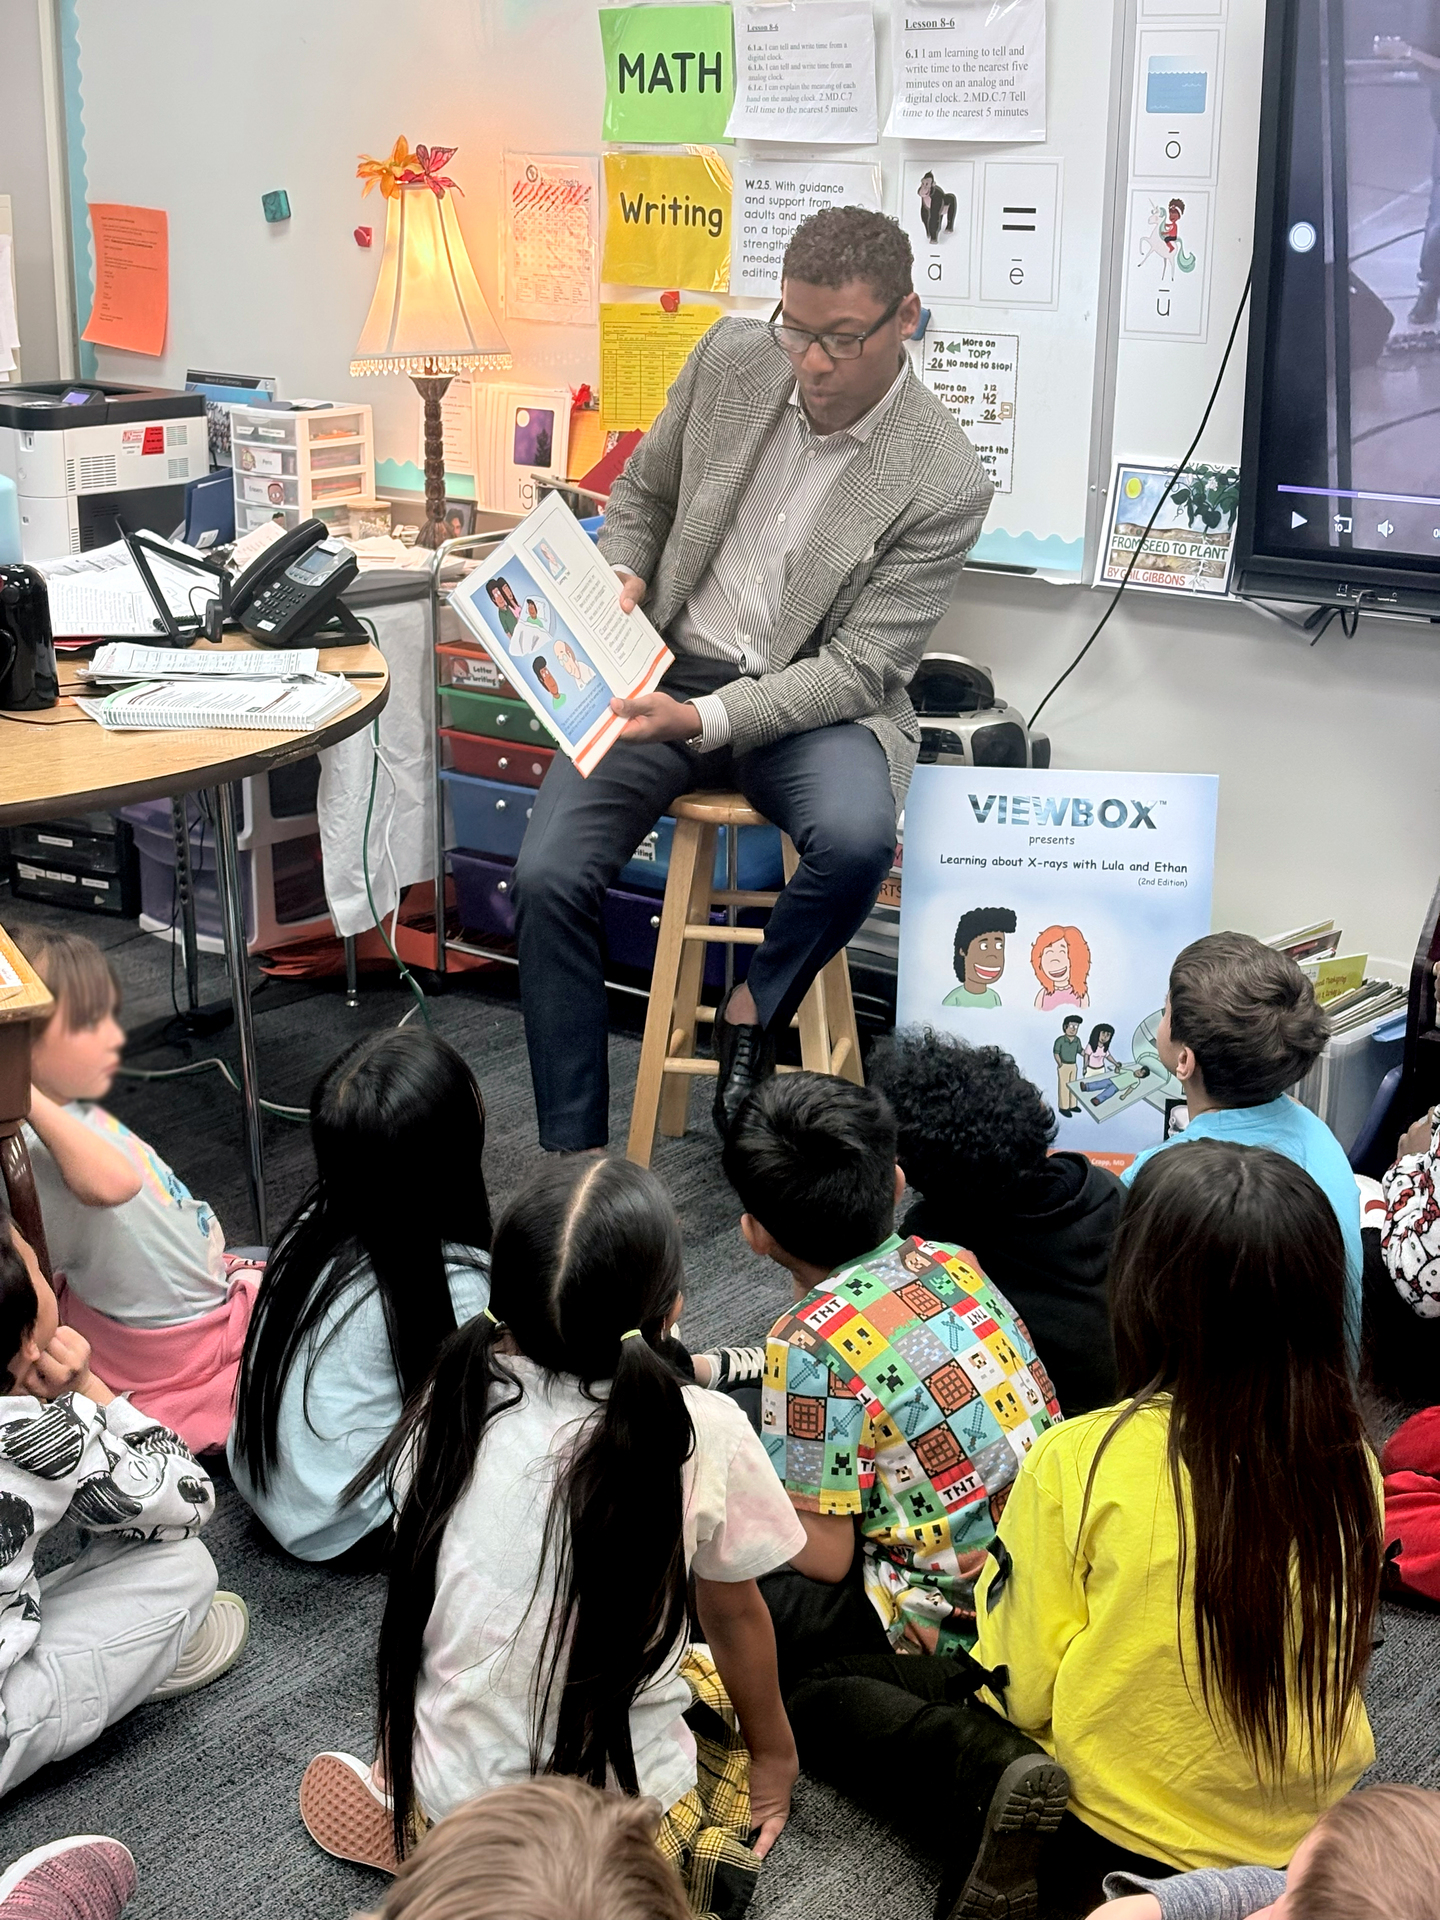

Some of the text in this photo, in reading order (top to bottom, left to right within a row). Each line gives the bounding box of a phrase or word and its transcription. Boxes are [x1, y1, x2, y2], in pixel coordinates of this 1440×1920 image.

[905, 18, 955, 29] Lesson 8-6
[906, 49, 918, 58] 6.1
[922, 49, 925, 58] I
[929, 50, 941, 58] am
[944, 47, 978, 59] learning
[992, 46, 1006, 56] tell
[1009, 45, 1024, 56] and
[906, 61, 1028, 73] write time to the nearest five
[619, 52, 722, 94] MATH
[906, 79, 940, 88] minutes
[955, 79, 965, 87] an
[968, 77, 996, 89] analog
[999, 76, 1014, 87] and
[905, 91, 1026, 105] digital clock. 2.MD.C.7 Tell
[902, 107, 1028, 117] time to the nearest 5 minutes
[775, 180, 795, 191] With
[800, 182, 844, 194] guidance
[745, 195, 831, 208] and support from
[620, 192, 723, 237] Writing
[744, 210, 775, 220] adults
[779, 212, 796, 220] and
[743, 240, 788, 251] strengthe
[743, 254, 780, 264] needed
[742, 269, 780, 280] editing.
[933, 341, 944, 353] 78
[963, 338, 983, 347] More
[968, 350, 991, 359] TOP?
[928, 358, 943, 368] -26
[947, 359, 957, 367] No
[960, 361, 978, 369] need
[934, 382, 954, 391] More
[940, 394, 974, 404] FLOOR?
[983, 393, 996, 404] 42
[980, 409, 996, 420] -26
[975, 444, 1008, 454] bers the
[981, 455, 997, 464] ME?
[1334, 524, 1343, 532] 10
[1111, 535, 1229, 560] FROM SEED TO PLANT
[1107, 567, 1119, 577] BY
[1142, 572, 1185, 586] GIBBONS
[968, 794, 1157, 830] VIEWBOX
[1029, 835, 1075, 846] presents
[940, 855, 1188, 873] Learning about X-rays with Lula and Ethan
[1138, 877, 1188, 888] (2nd Edition)
[810, 1299, 840, 1324] TNT
[942, 1476, 976, 1501] TNT
